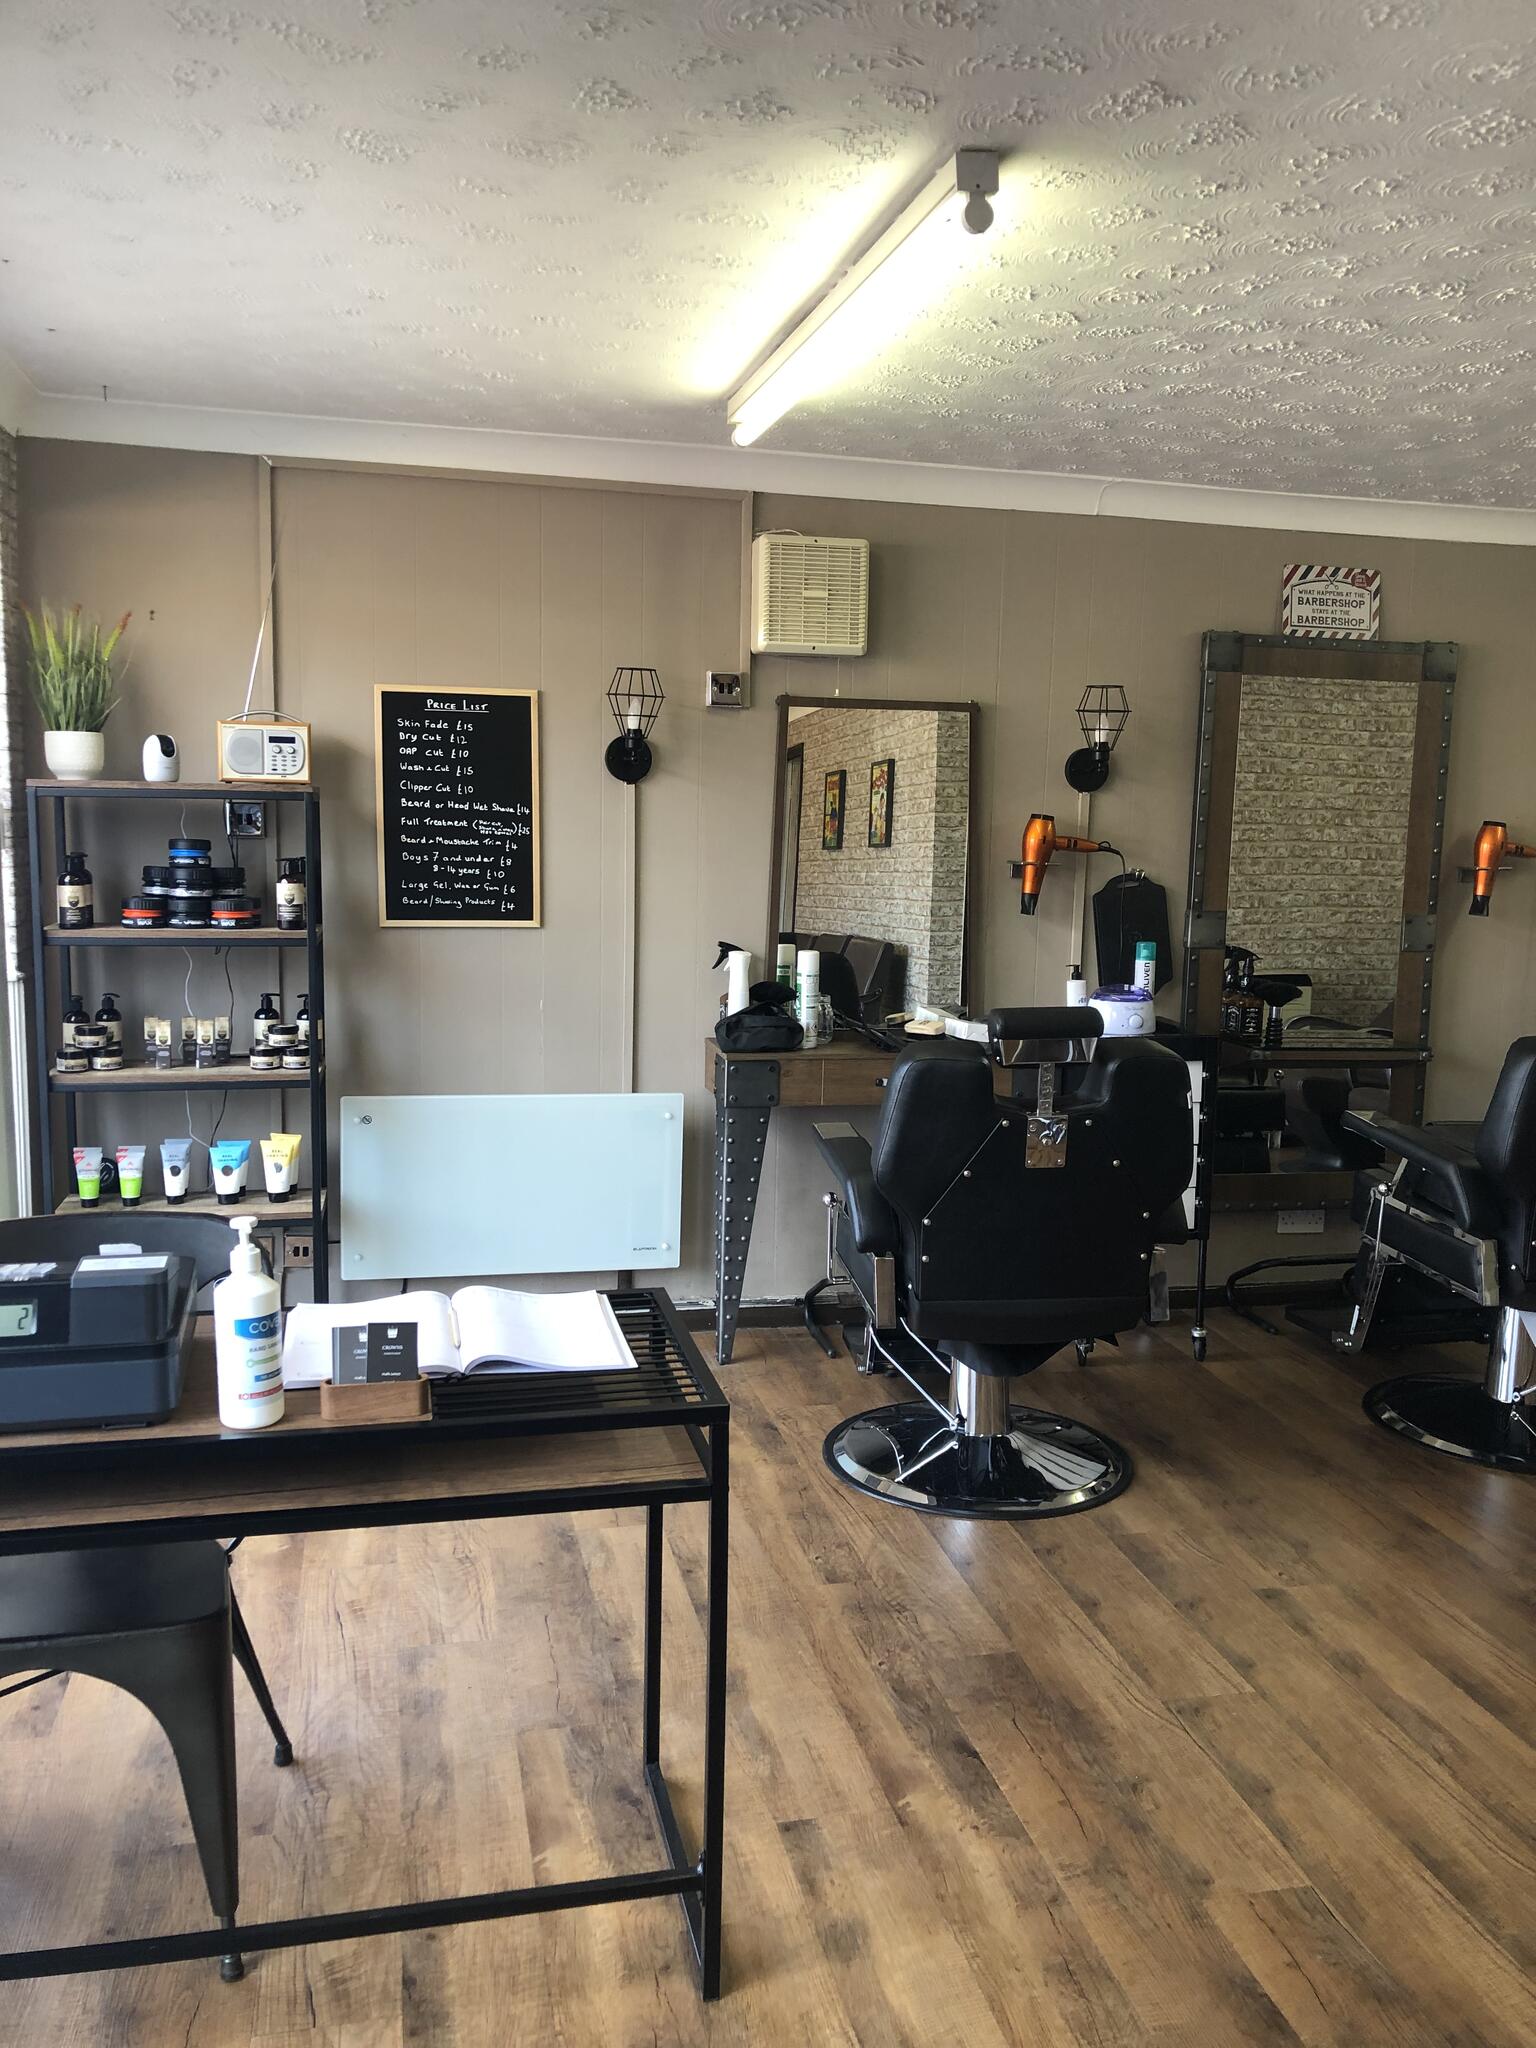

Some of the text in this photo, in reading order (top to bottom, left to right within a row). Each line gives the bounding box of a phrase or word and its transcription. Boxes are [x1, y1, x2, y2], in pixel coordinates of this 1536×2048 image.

[1297, 597, 1365, 609] BARBERSHOP
[1297, 615, 1364, 627] BARBERSHOP
[426, 698, 489, 710] PRICE LIST
[397, 718, 473, 731] Skin Fade £15
[399, 732, 417, 742] Dry
[450, 734, 467, 744] £12
[399, 747, 417, 755] OAP
[451, 749, 469, 758] £10
[400, 762, 424, 771] Wash
[456, 766, 473, 776] £15
[400, 780, 473, 794] Clipper Cut £10
[401, 798, 430, 808] Beard
[448, 801, 469, 810] Head
[473, 802, 488, 811] Wet
[401, 817, 530, 836] Full Treatment £25
[401, 835, 426, 843] Beard
[436, 837, 479, 845] Moustache
[506, 840, 518, 851] £4
[403, 852, 428, 864] Boys
[433, 852, 439, 861] 7
[501, 856, 512, 866] £8
[458, 868, 480, 876] years
[487, 869, 505, 879] £10
[402, 880, 428, 891] Large
[504, 884, 515, 895] £6
[465, 897, 495, 905] Products
[501, 901, 515, 912] £4
